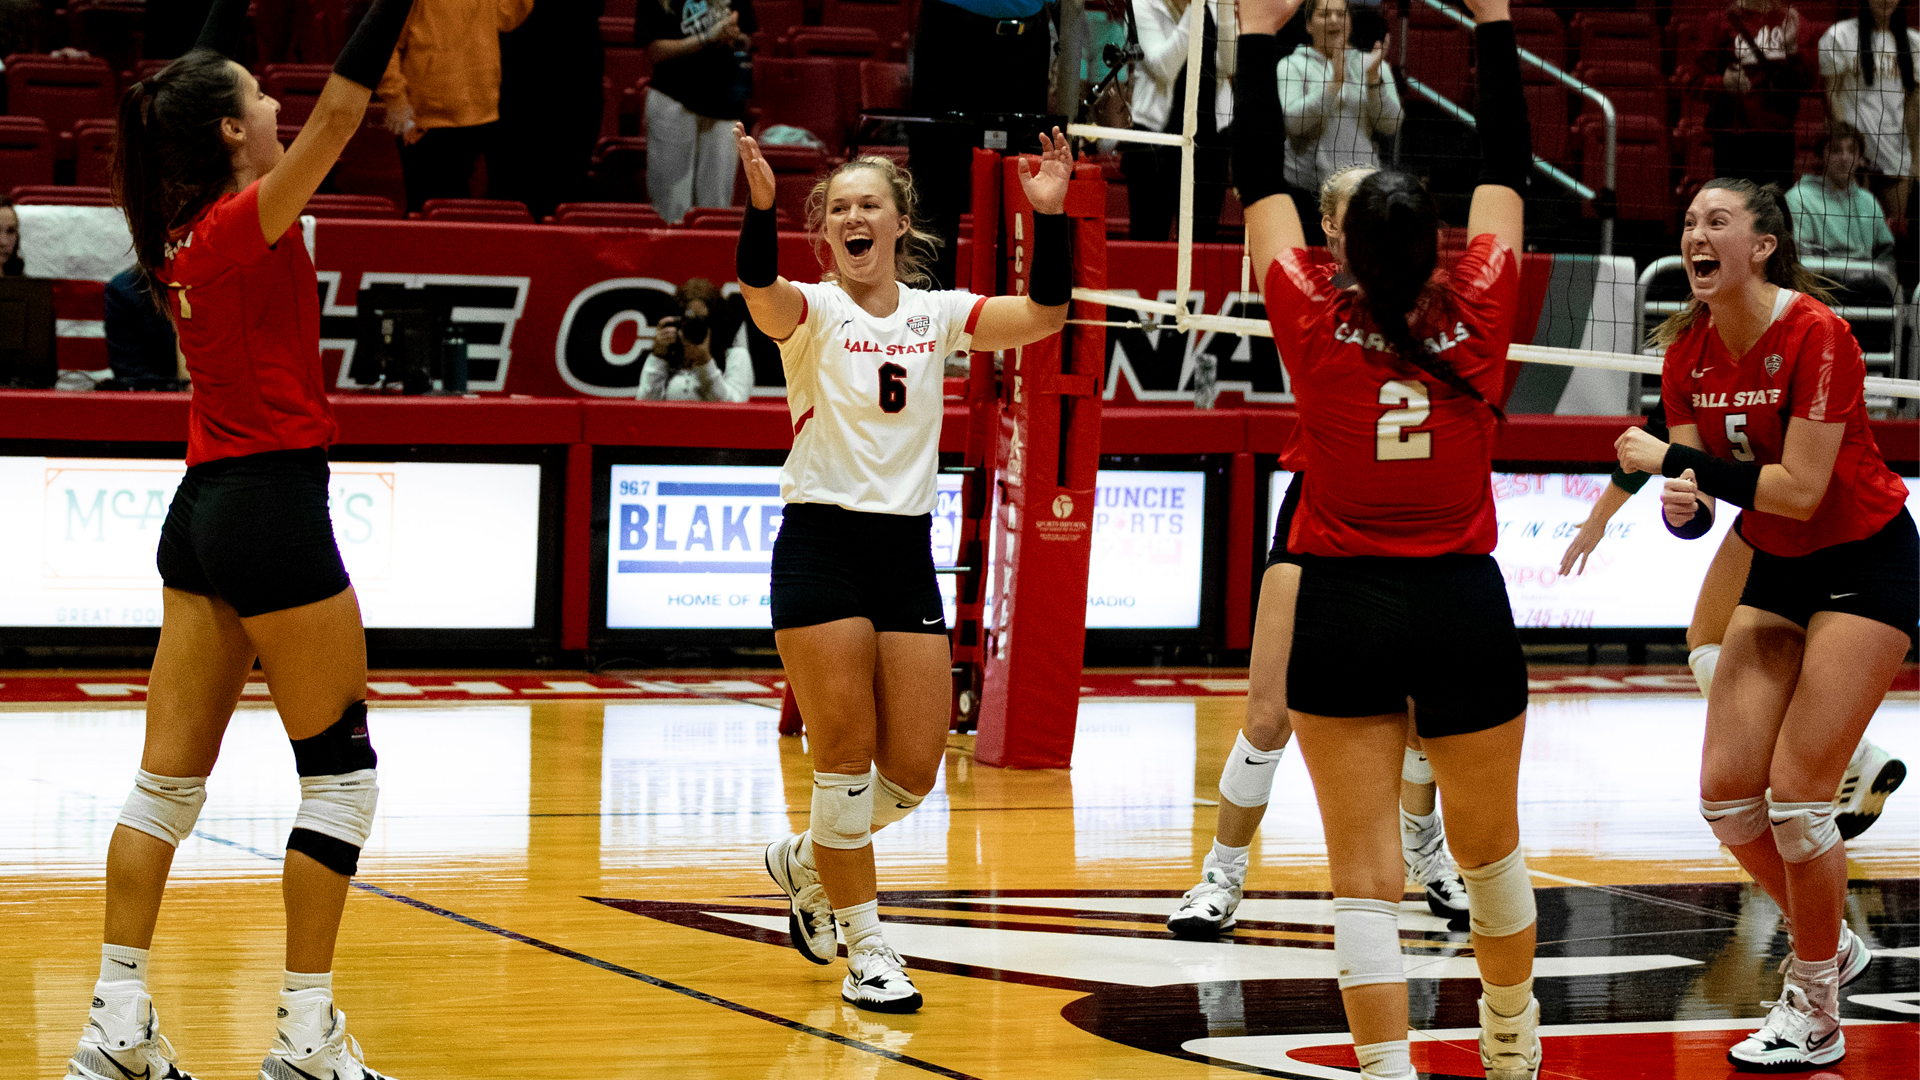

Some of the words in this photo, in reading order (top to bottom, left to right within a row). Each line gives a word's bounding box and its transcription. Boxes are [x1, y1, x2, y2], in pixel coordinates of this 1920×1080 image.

[885, 340, 937, 356] STATE
[878, 361, 907, 413] 6
[1732, 388, 1782, 407] STATE
[1375, 379, 1432, 461] 2
[1725, 413, 1756, 462] 5
[619, 480, 651, 496] 96.7
[1492, 474, 1549, 501] EST
[1561, 474, 1602, 503] WA
[619, 503, 783, 552] BLAKE
[1520, 520, 1546, 538] IN
[667, 593, 722, 607] HOME
[728, 593, 753, 607] OF
[55, 607, 113, 623] GREAT
[121, 607, 164, 623] FOO
